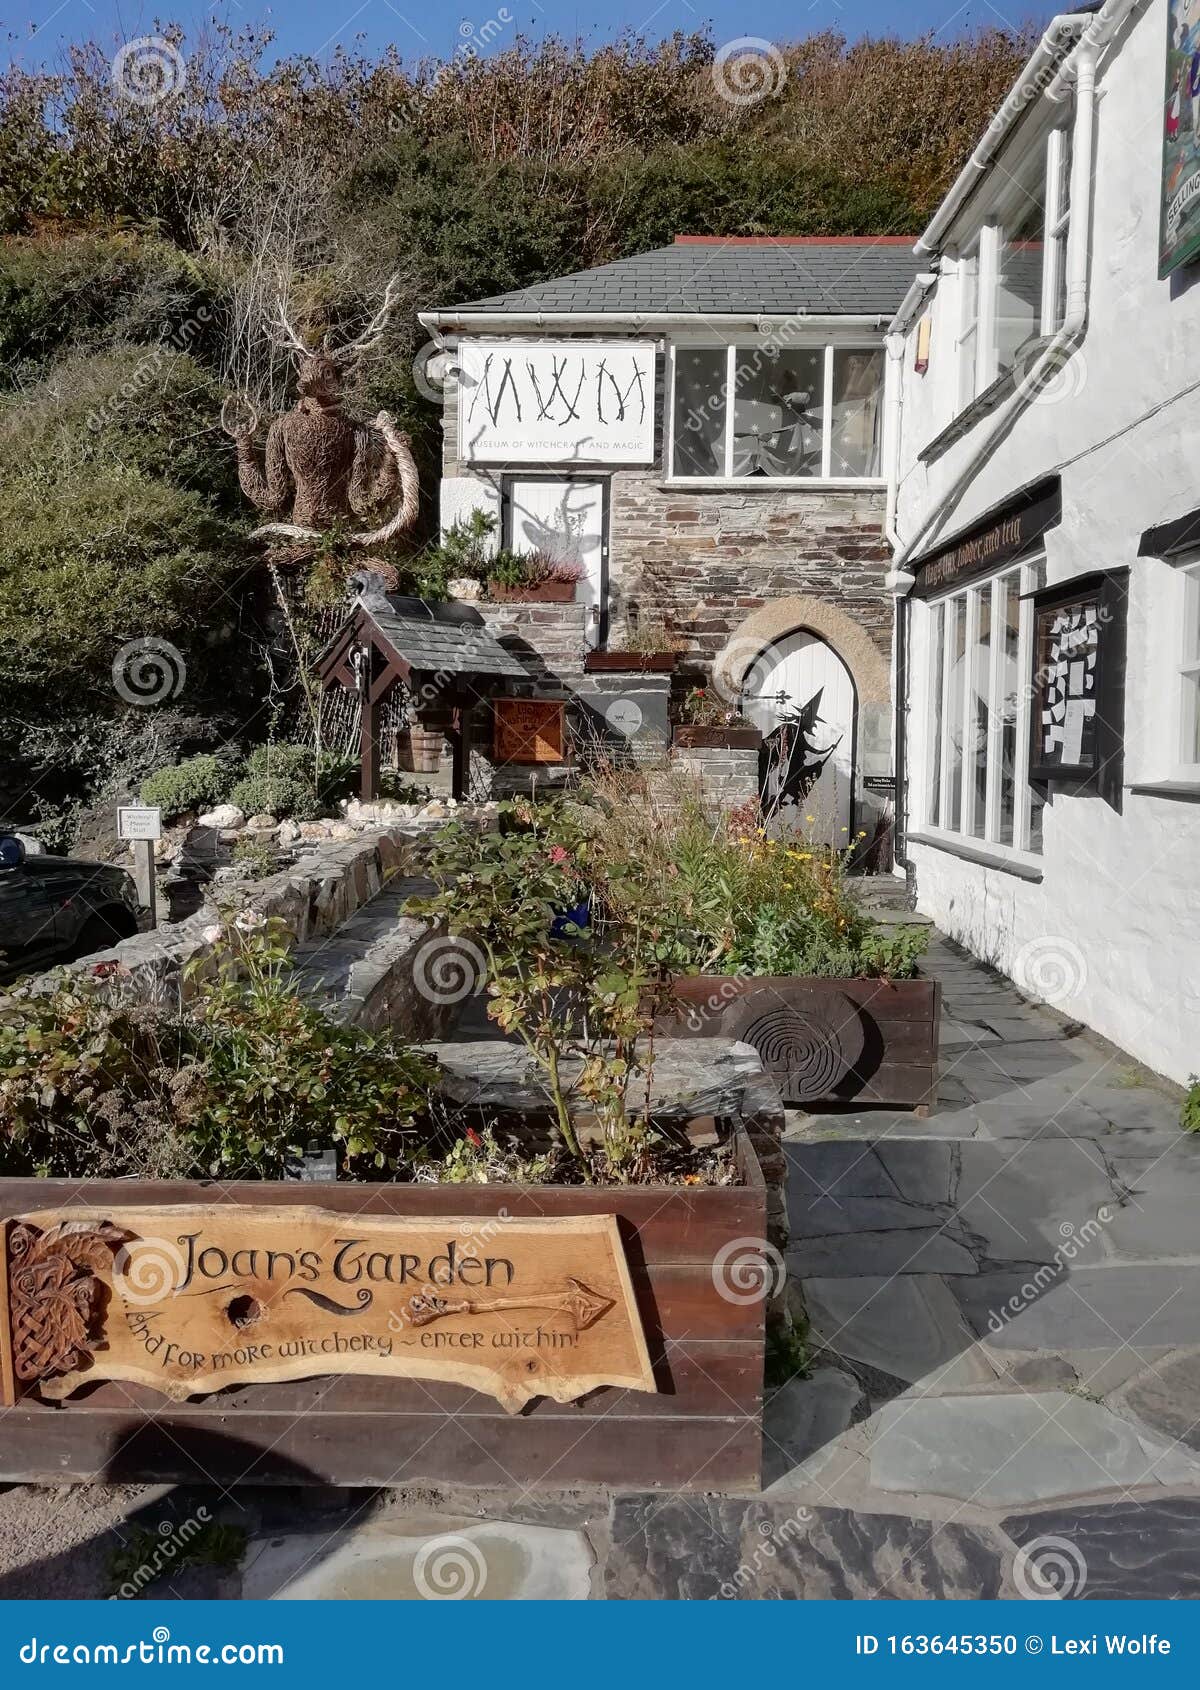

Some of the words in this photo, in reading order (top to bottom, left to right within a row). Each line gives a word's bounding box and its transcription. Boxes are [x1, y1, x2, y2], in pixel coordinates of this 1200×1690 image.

[470, 440, 509, 449] MUSEUM
[512, 440, 524, 449] OF
[528, 440, 586, 449] WITCHCRAFT
[589, 440, 609, 449] AND
[613, 441, 643, 450] MAGIC
[171, 1230, 323, 1291] Joan's
[332, 1239, 515, 1287] Garden
[161, 1343, 206, 1369] for
[211, 1344, 274, 1369] more
[278, 1331, 393, 1357] witchery
[420, 1331, 485, 1348] enter
[491, 1326, 579, 1349] within!
